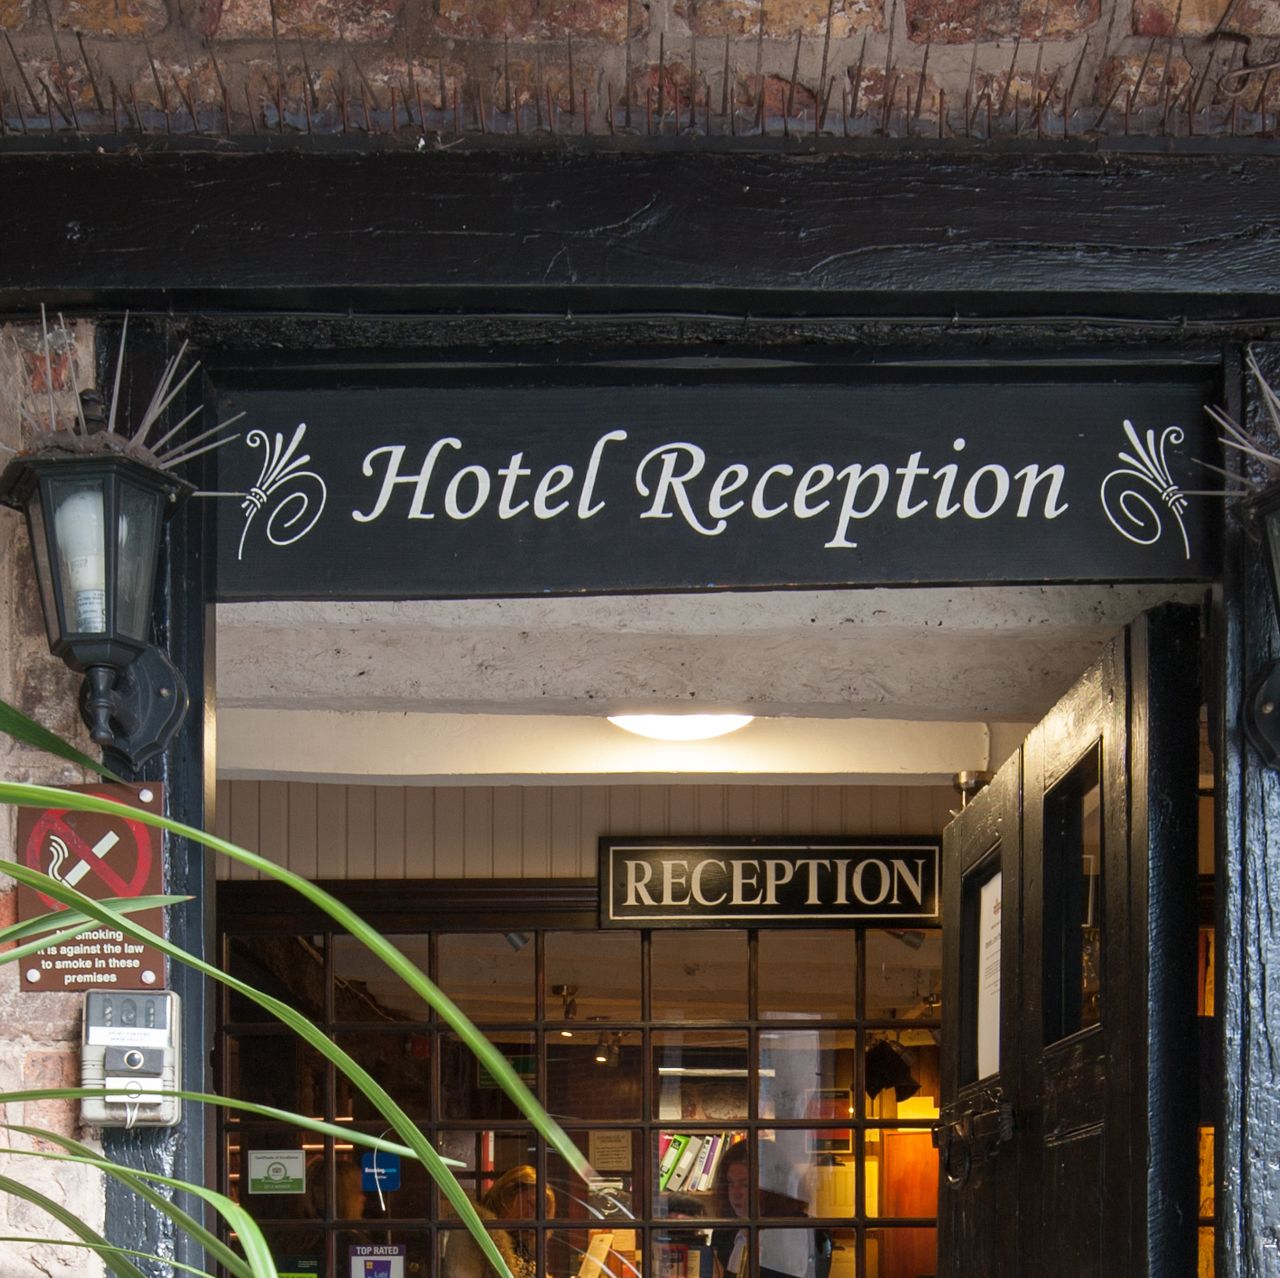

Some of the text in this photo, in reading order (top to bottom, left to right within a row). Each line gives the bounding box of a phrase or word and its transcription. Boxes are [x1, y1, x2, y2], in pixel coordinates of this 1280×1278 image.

[351, 429, 1070, 549] Hotel Reception
[622, 857, 928, 909] RECEPTION
[74, 929, 124, 942] smoking
[47, 946, 58, 955] is
[59, 944, 101, 957] against
[103, 944, 122, 954] the
[124, 943, 144, 954] law
[41, 958, 140, 969] to smoke in these
[64, 973, 118, 985] premises
[356, 1246, 399, 1255] TOP RATED
